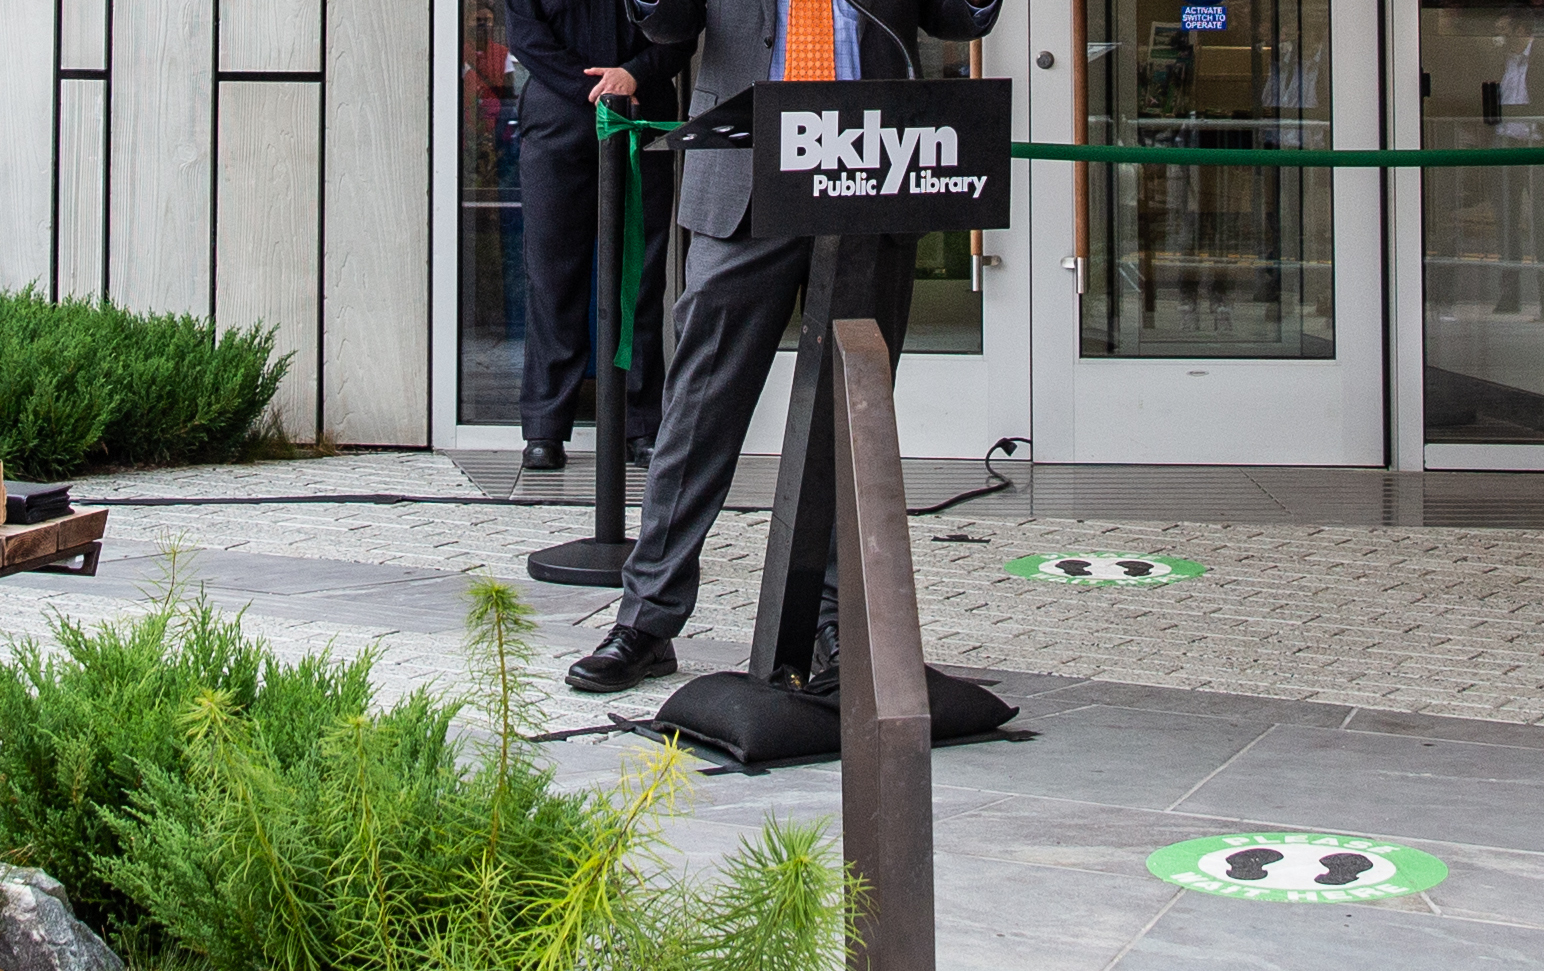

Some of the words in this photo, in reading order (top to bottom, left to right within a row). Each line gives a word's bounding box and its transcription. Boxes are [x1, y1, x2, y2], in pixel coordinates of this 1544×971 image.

[1182, 14, 1213, 22] SWITCH
[1215, 14, 1226, 22] TO
[1185, 6, 1223, 14] ACTIVATE
[1185, 21, 1223, 29] OPERATE
[780, 109, 958, 195] Bklyn
[813, 172, 877, 197] Public
[909, 169, 988, 199] Library
[1221, 834, 1402, 854] PLEASE
[1170, 871, 1271, 899] WAIT
[1287, 883, 1411, 903] HERE
